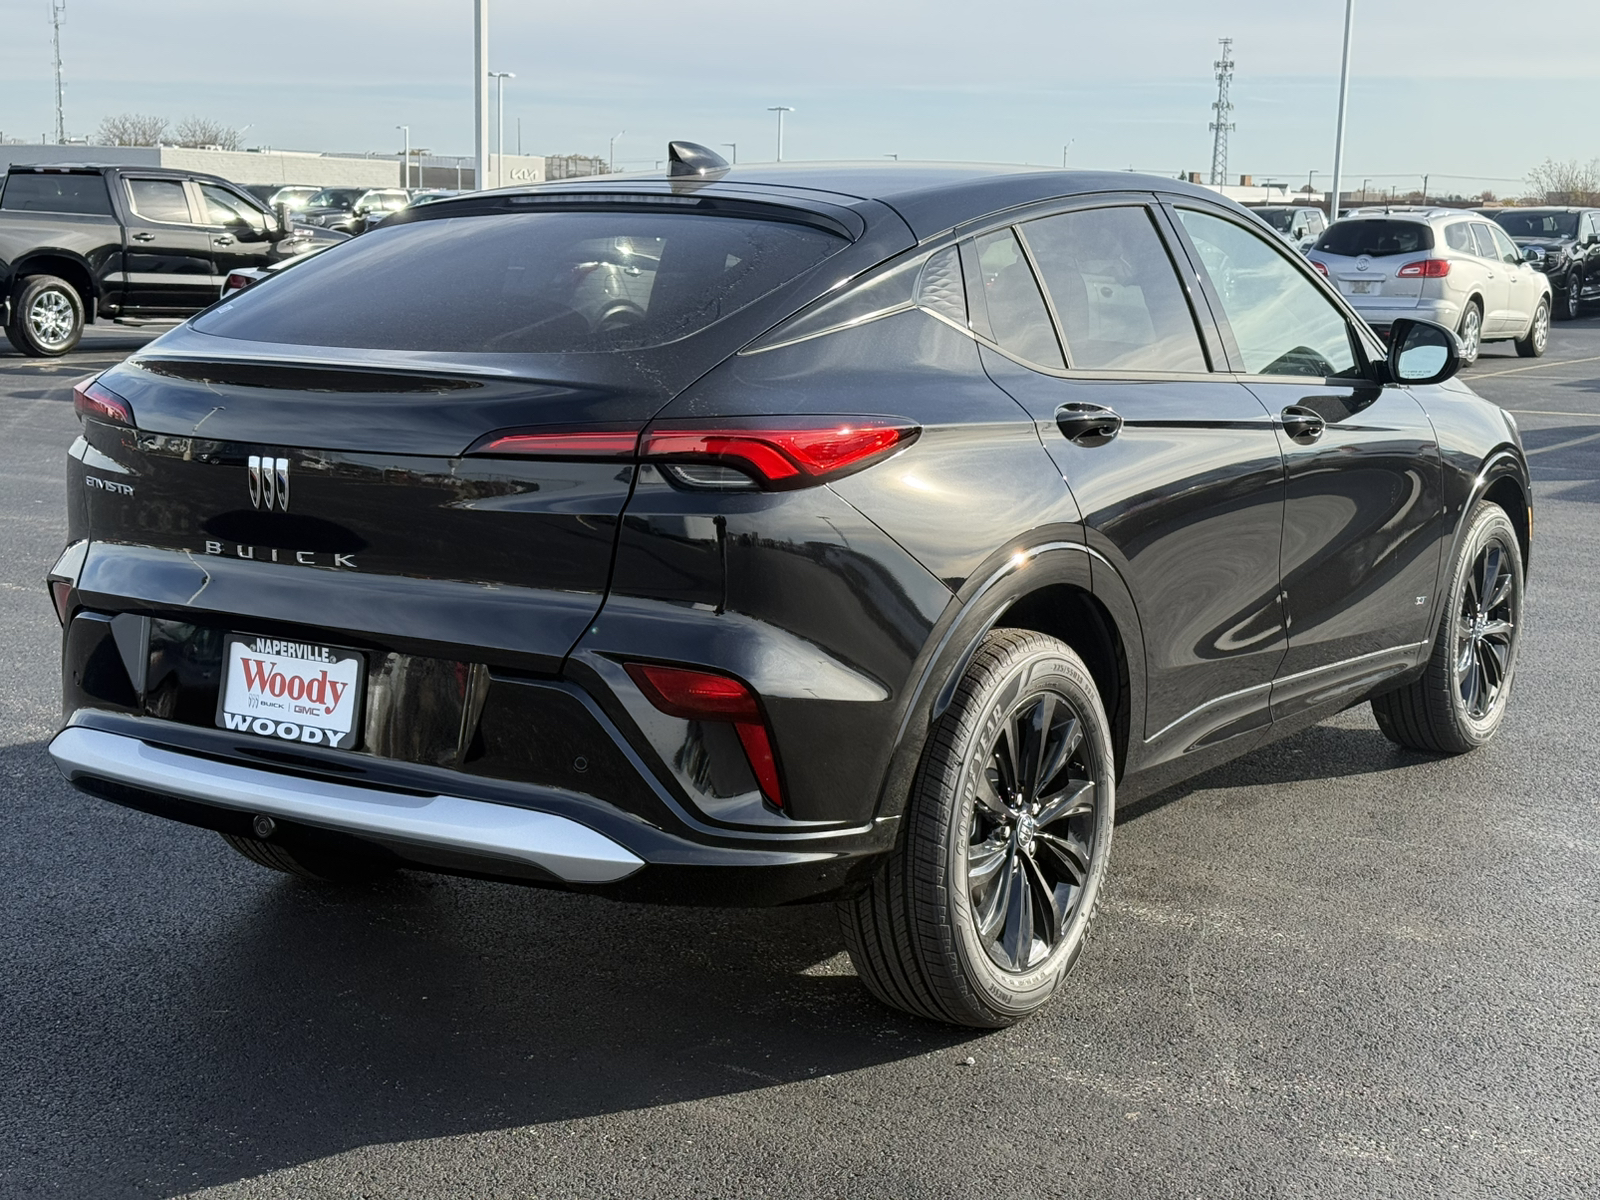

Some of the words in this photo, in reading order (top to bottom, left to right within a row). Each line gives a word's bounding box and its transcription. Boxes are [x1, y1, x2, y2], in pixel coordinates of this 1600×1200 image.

[205, 540, 358, 568] BUICK
[256, 637, 330, 663] NAPERVILLE
[240, 657, 349, 715] Woody
[260, 700, 285, 709] BUICK
[293, 705, 321, 717] GMC
[223, 712, 347, 748] WOODY
[956, 703, 1003, 855] GOODYEAR
